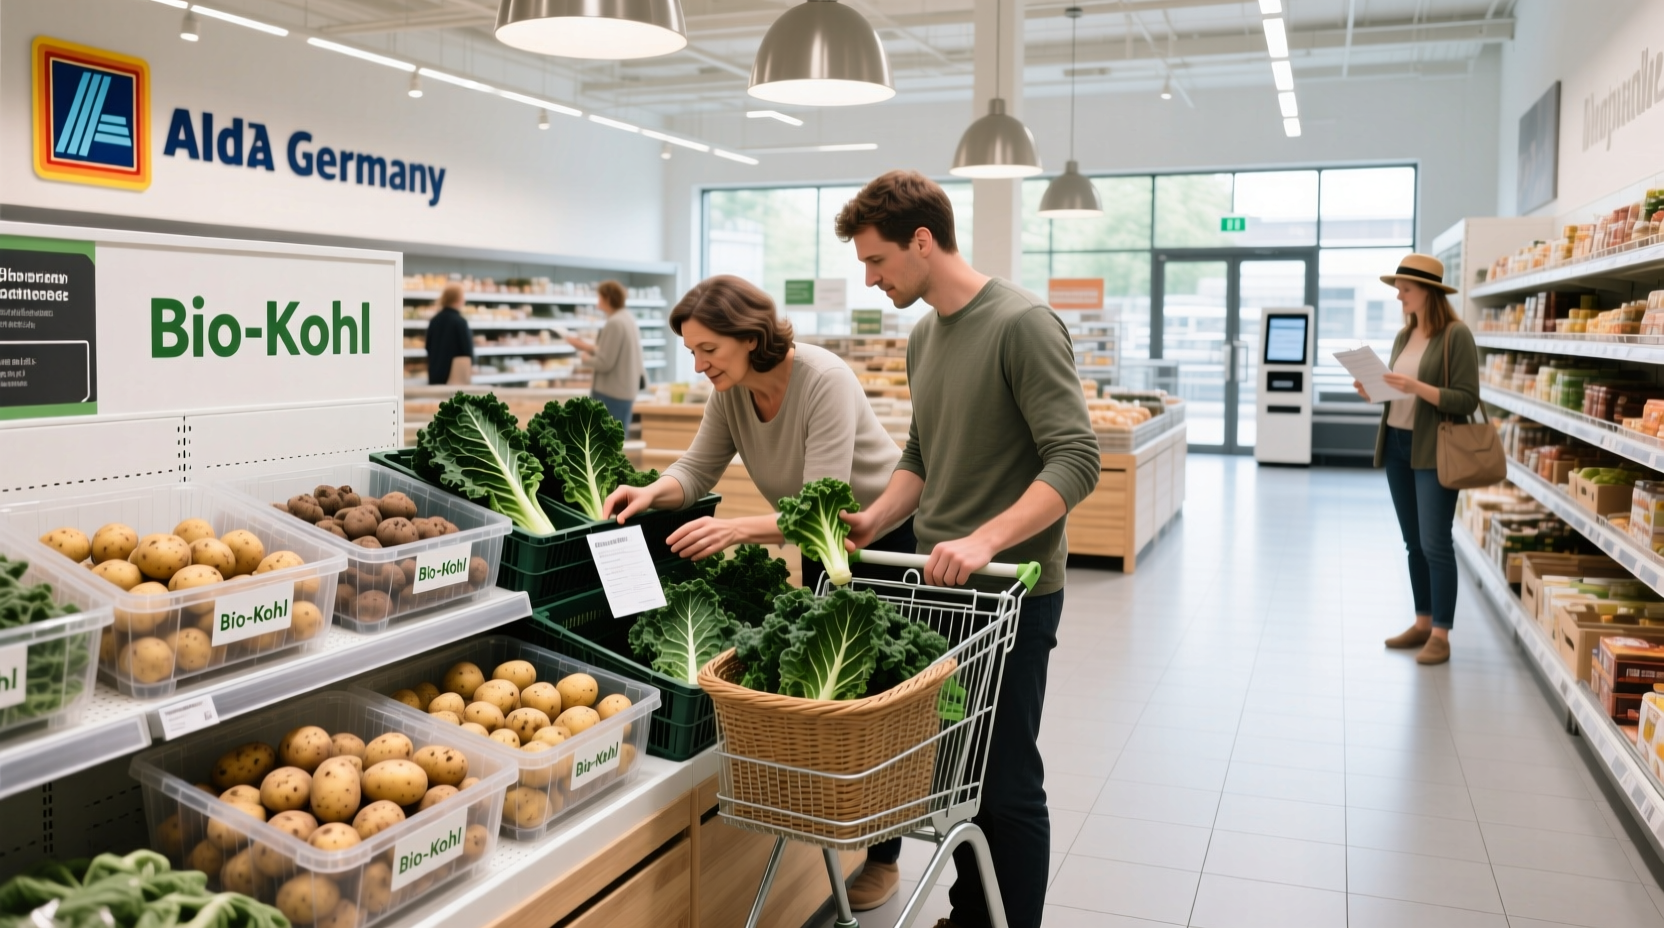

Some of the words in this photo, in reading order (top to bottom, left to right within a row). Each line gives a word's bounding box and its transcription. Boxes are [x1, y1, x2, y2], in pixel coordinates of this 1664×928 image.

[287, 131, 446, 206] Germany
[151, 296, 369, 358] Bio-Kohl
[220, 599, 288, 632] Bio-Kohl
[399, 826, 462, 875] Bio-Kohl
